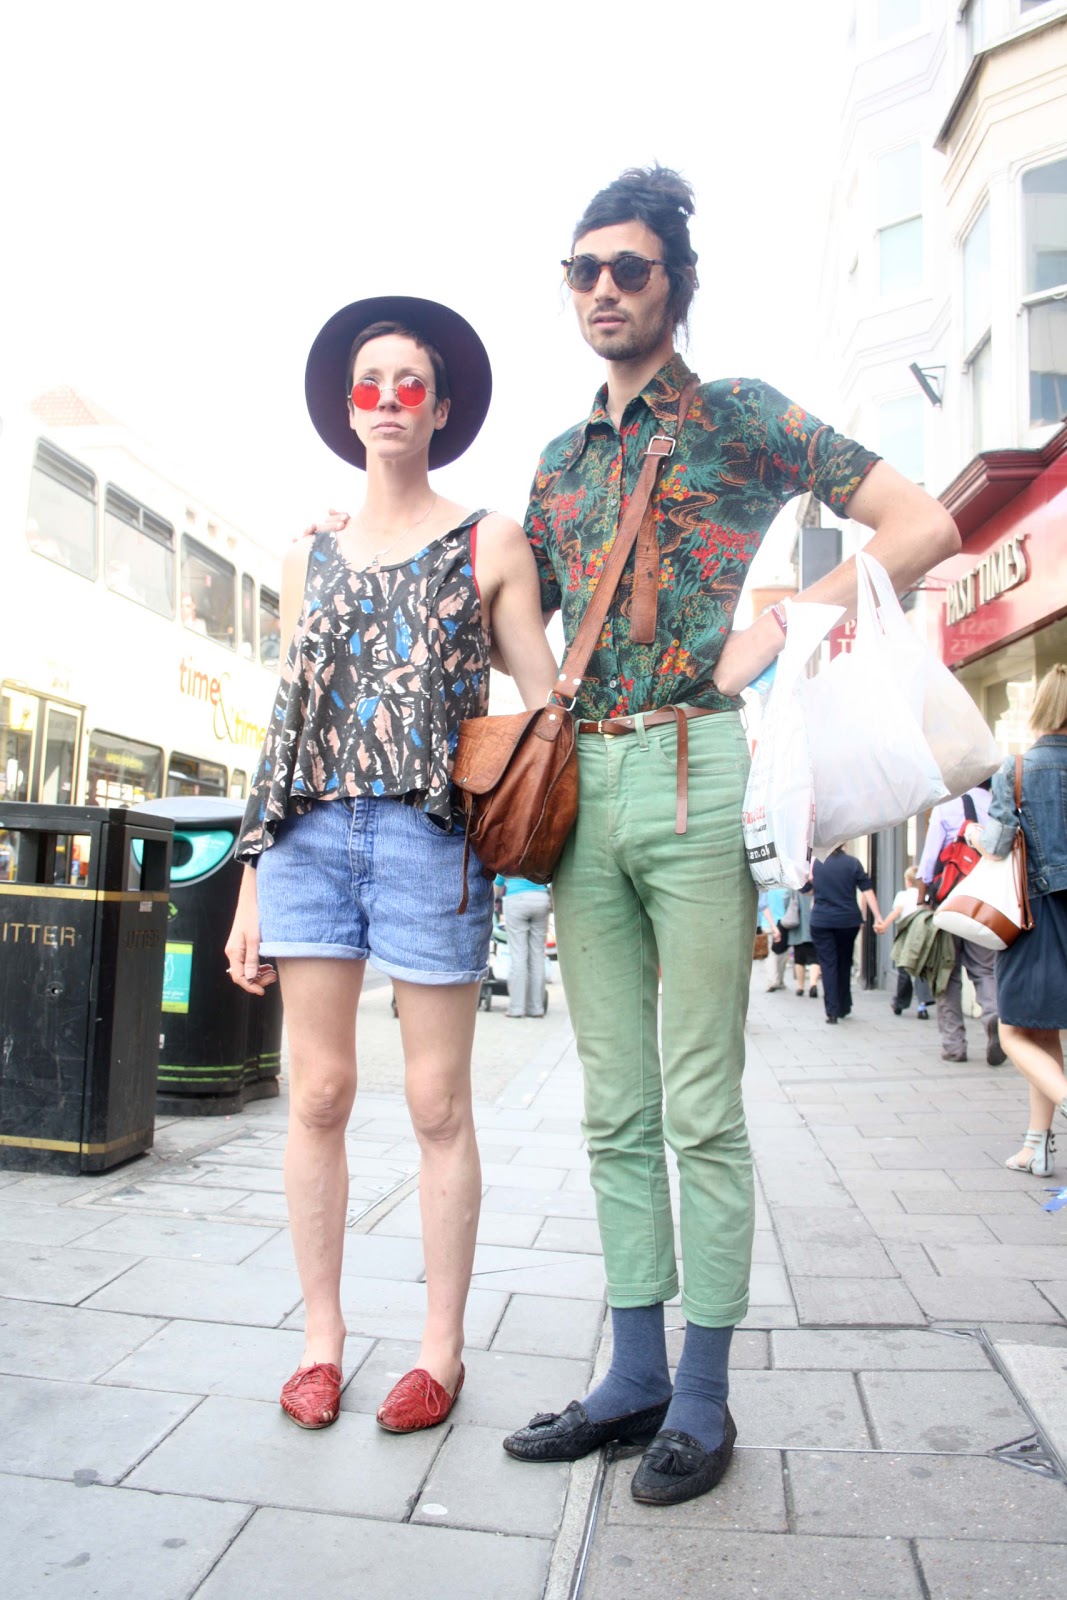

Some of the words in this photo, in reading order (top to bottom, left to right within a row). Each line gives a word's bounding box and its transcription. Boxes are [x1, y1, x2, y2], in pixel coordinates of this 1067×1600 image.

[946, 568, 979, 626] PAST
[976, 533, 1029, 606] TIMES
[179, 656, 220, 706] time
[235, 709, 267, 750] time
[2, 922, 76, 947] ITTER
